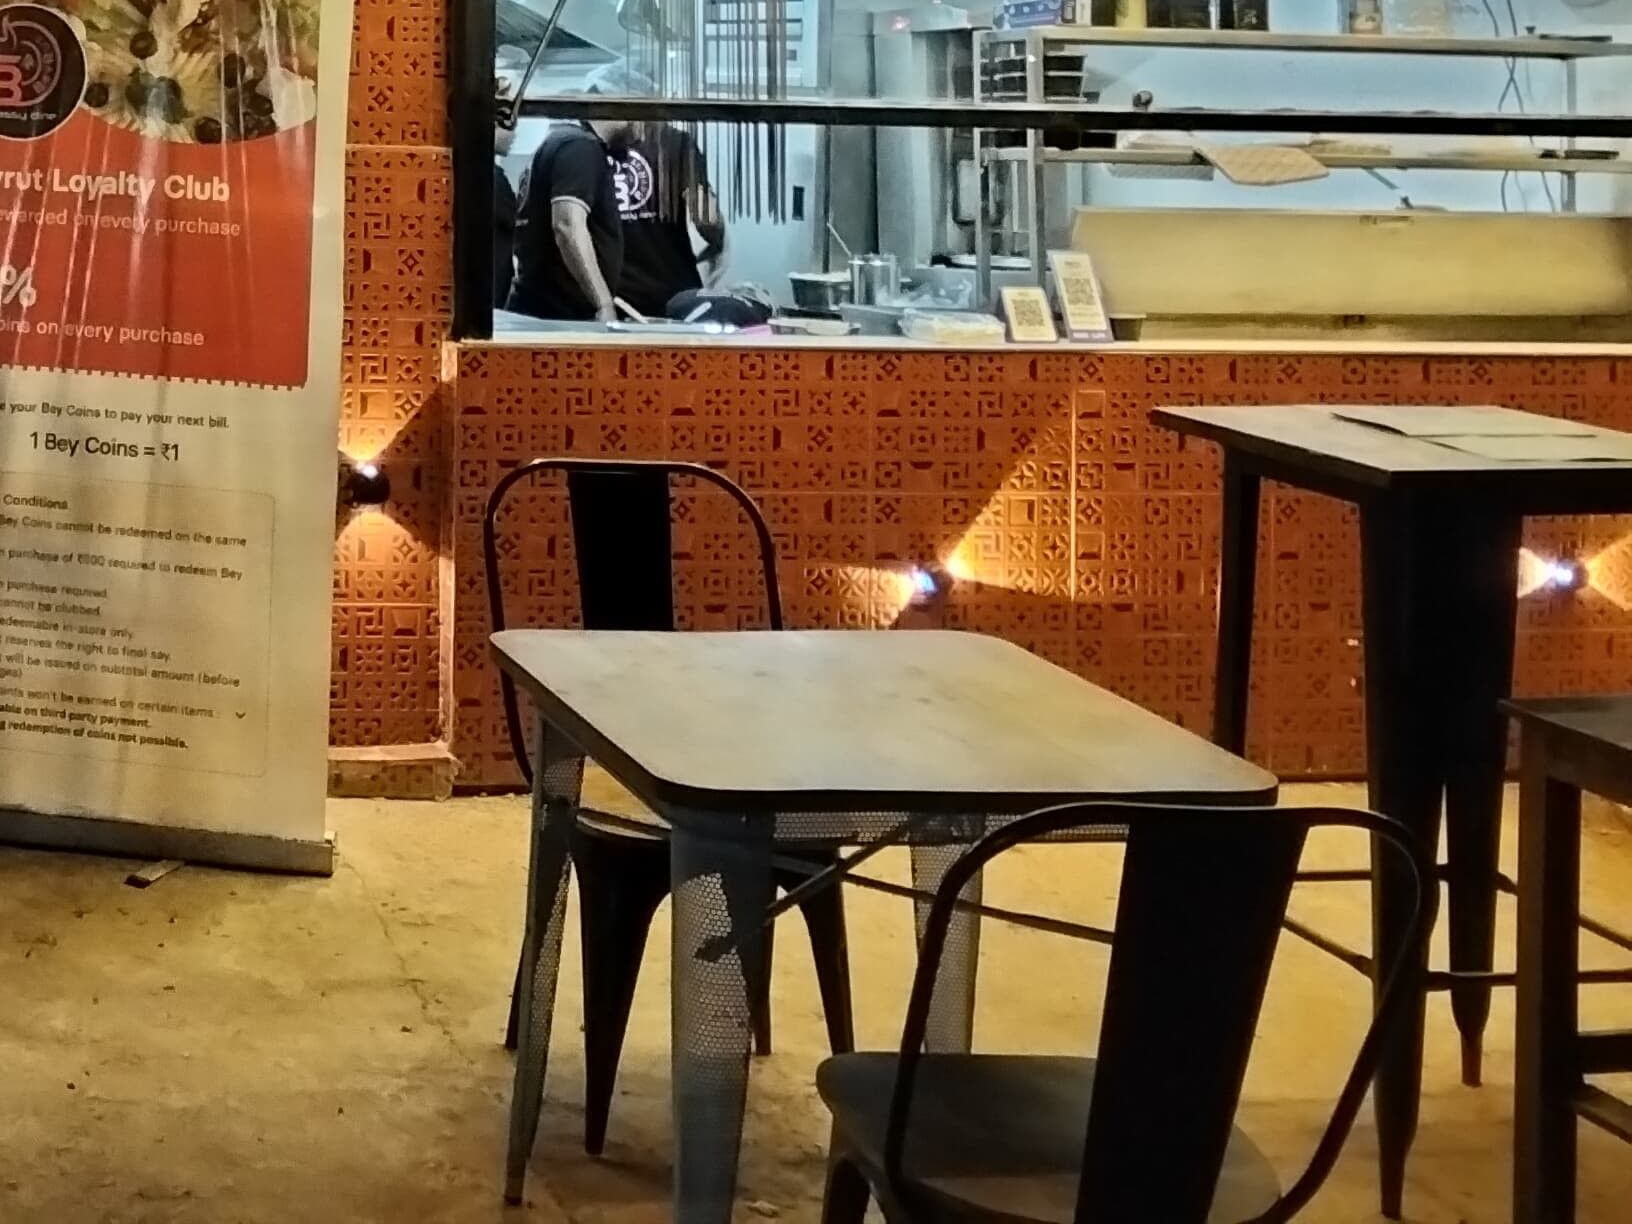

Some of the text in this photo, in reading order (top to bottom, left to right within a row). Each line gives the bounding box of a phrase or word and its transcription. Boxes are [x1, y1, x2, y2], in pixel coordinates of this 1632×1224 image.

[52, 167, 156, 205] Loyalty
[164, 173, 230, 202] Club
[99, 214, 151, 236] every
[154, 216, 241, 238] purchase
[36, 321, 59, 335] on
[64, 323, 115, 344] every
[119, 325, 206, 346] purchase
[9, 402, 38, 415] your
[41, 401, 63, 417] Bey
[66, 405, 101, 419] Coins
[104, 408, 118, 419] to
[120, 409, 143, 424] pay
[146, 413, 173, 426] your
[176, 415, 206, 427] next
[29, 431, 180, 463] 1 Bey Coins = ₹1
[2, 493, 69, 510] Conditions
[21, 516, 53, 530] Coins
[115, 526, 172, 541] redeemed
[175, 532, 191, 542] on
[193, 532, 212, 544] the
[215, 536, 248, 547] same
[106, 645, 120, 656] to
[122, 645, 148, 659] final
[150, 669, 195, 682] amount
[23, 707, 38, 717] on
[40, 706, 67, 719] third
[136, 701, 178, 715] certain
[8, 719, 71, 736] redemption
[73, 727, 85, 738] of
[86, 729, 116, 742] coins
